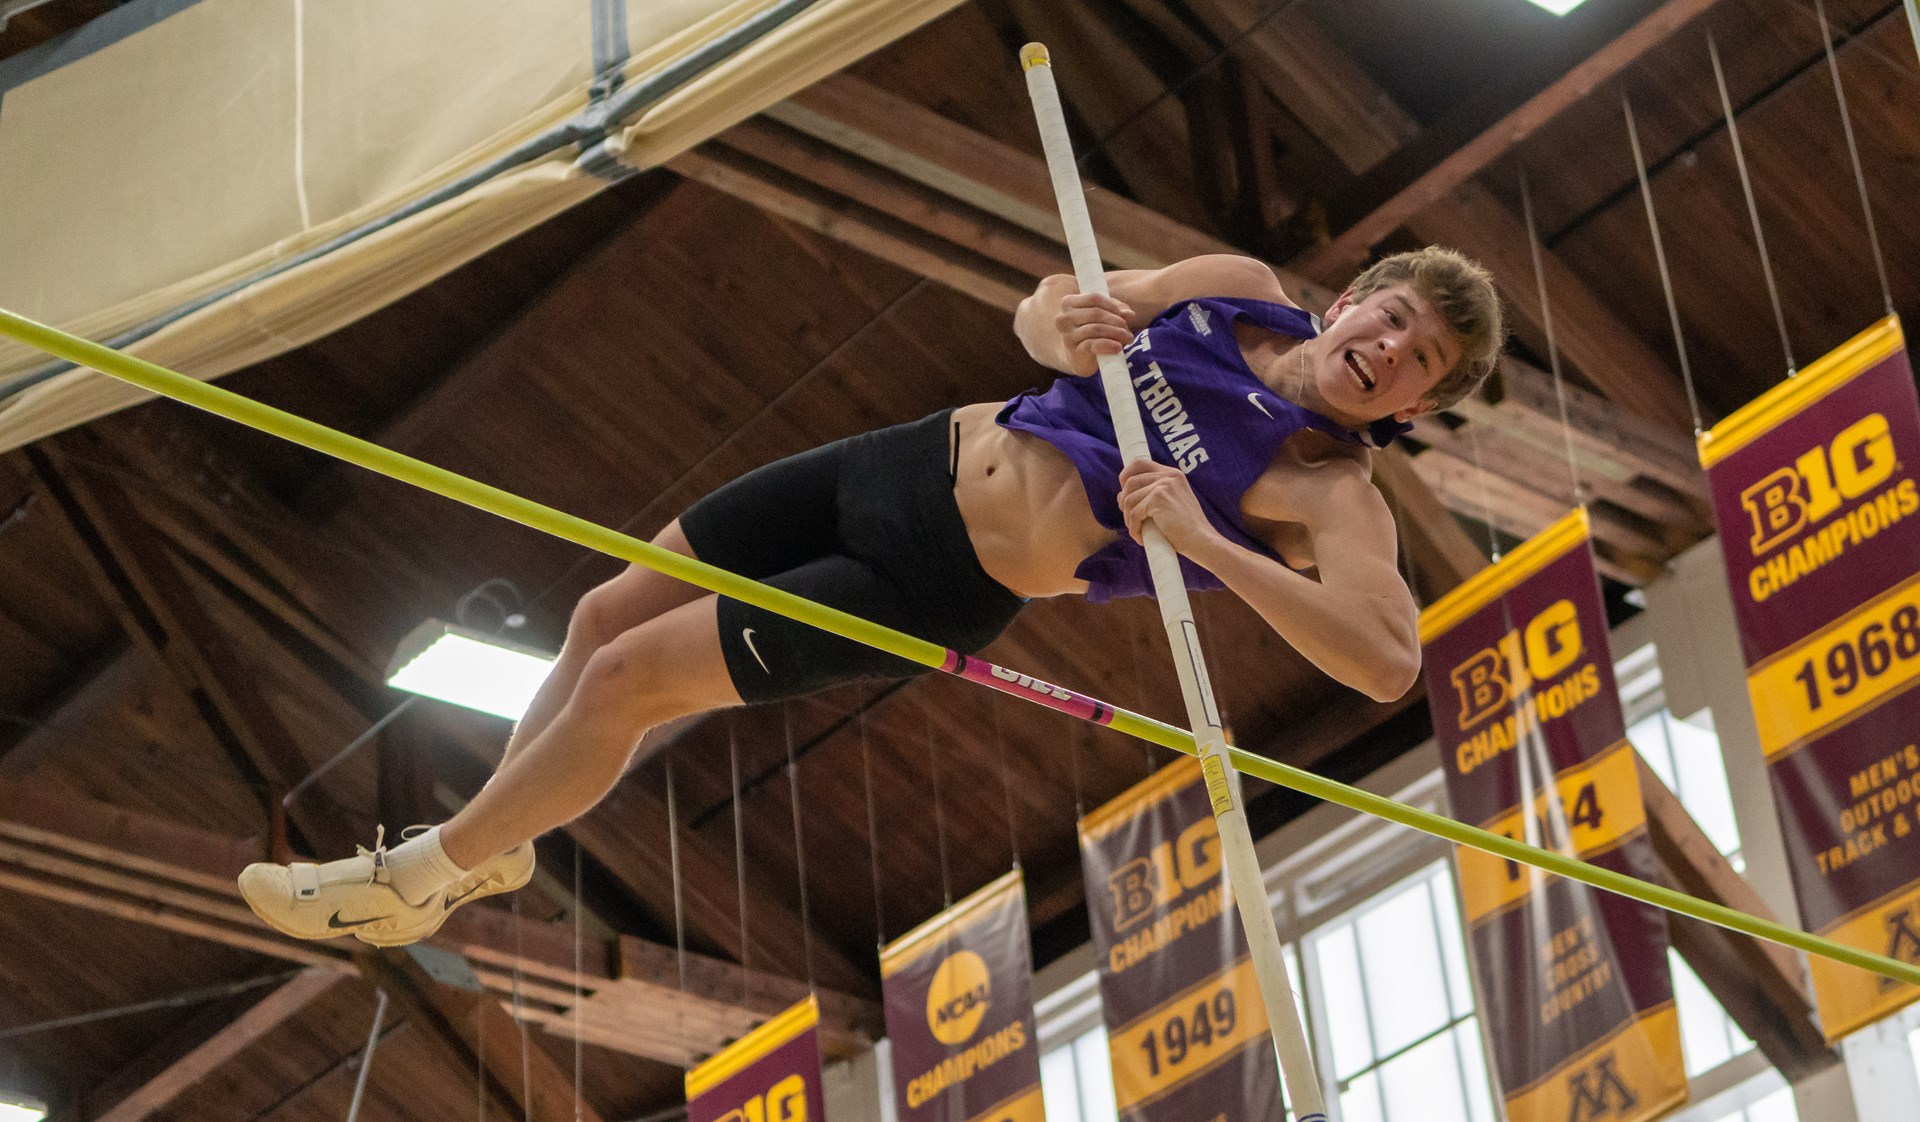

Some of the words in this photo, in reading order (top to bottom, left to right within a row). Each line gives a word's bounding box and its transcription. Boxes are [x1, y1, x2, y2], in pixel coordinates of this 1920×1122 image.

[1133, 361, 1210, 475] THOMAS
[1749, 479, 1919, 602] CHAMPIONS
[1794, 603, 1920, 712] 1968
[1850, 744, 1919, 798] MEN'S
[1503, 782, 1604, 882] 14
[1817, 823, 1887, 875] TRACK
[906, 1021, 1027, 1109] CHAMPIONS
[1139, 988, 1237, 1077] 1949
